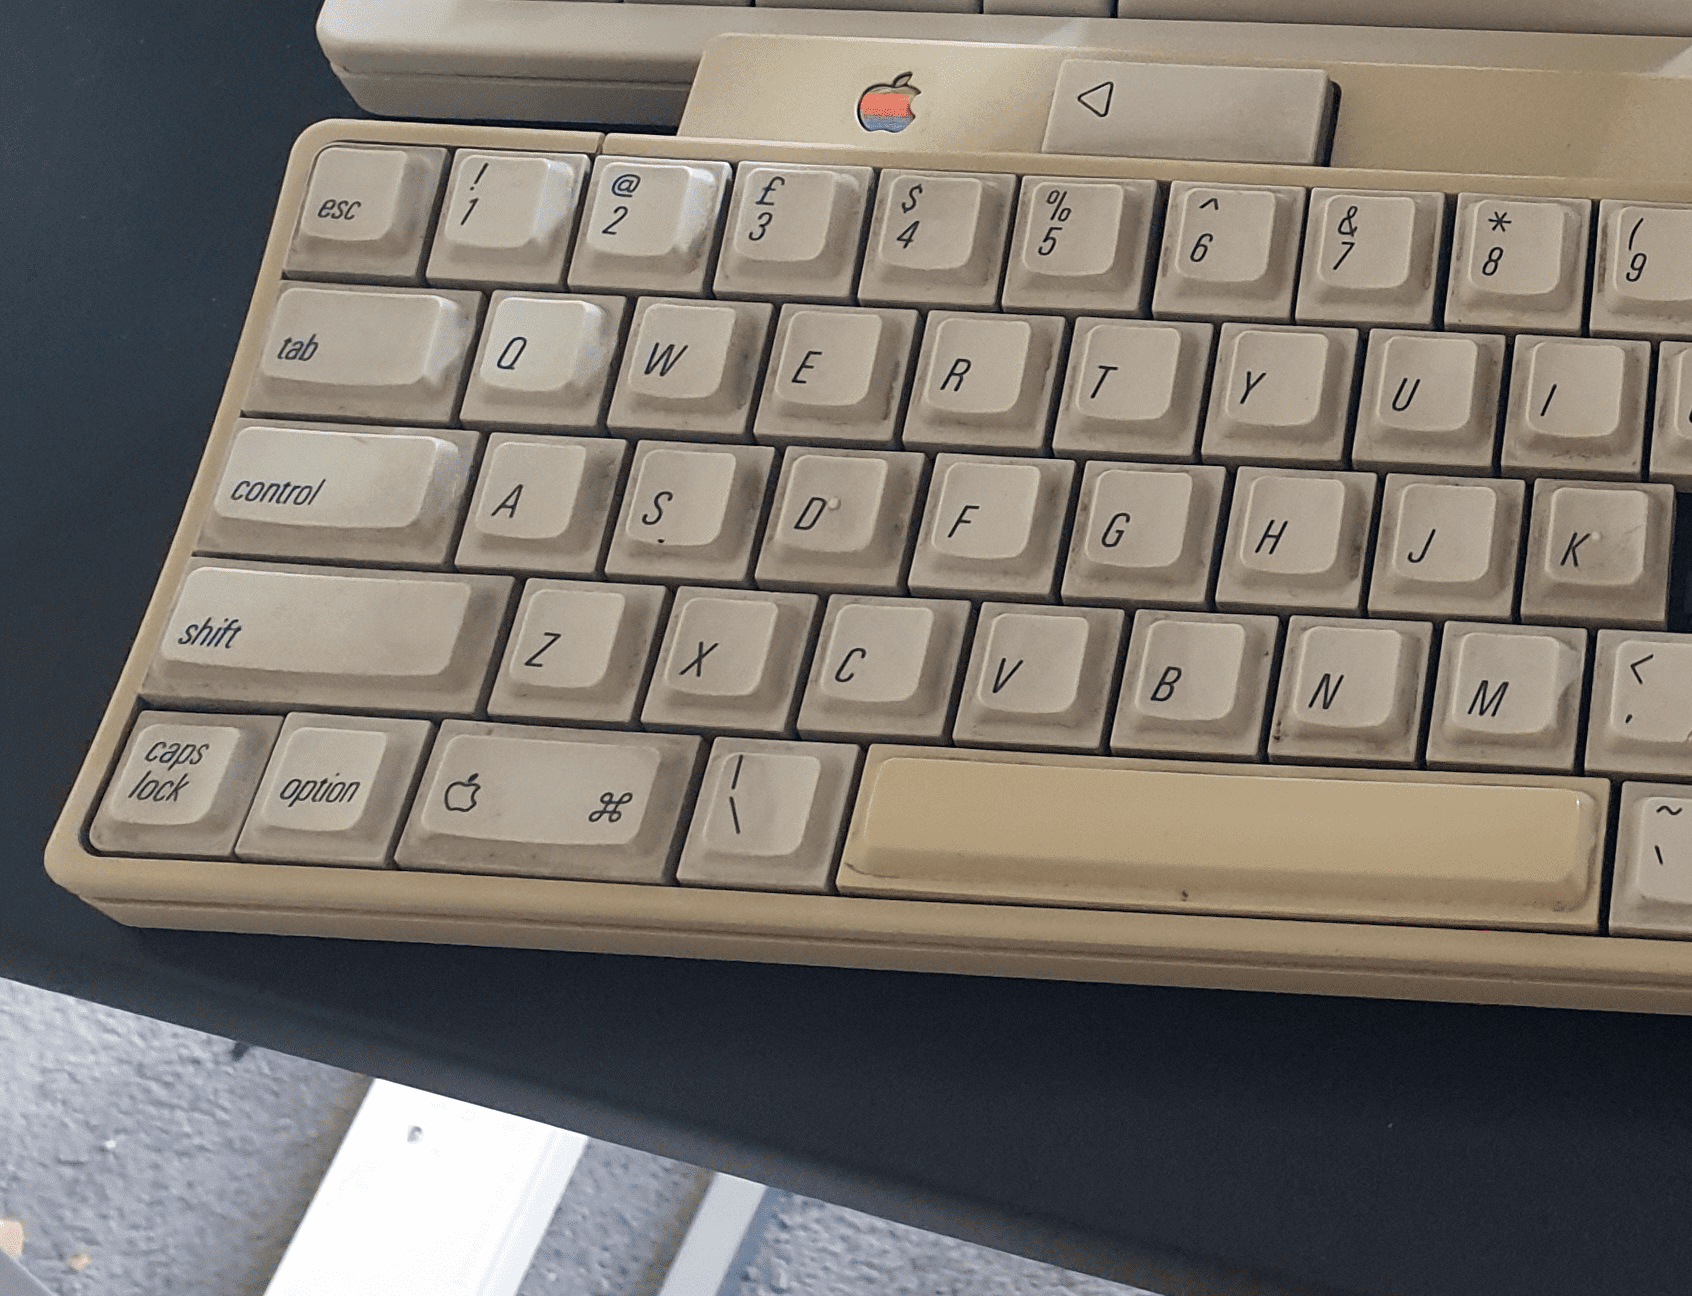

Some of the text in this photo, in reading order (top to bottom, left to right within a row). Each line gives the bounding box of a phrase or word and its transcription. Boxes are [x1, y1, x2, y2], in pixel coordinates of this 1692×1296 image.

[469, 162, 490, 191] !
[611, 173, 642, 198] @
[755, 176, 786, 206] £
[317, 198, 362, 221] esc
[460, 197, 479, 226] 1
[901, 183, 924, 214] $
[1045, 189, 1072, 222] %
[601, 205, 629, 236] 2
[748, 211, 773, 242] 3
[896, 220, 920, 249] 4
[1337, 205, 1359, 238] &
[1628, 217, 1644, 252] (
[1037, 226, 1063, 256] 5
[1189, 232, 1214, 263] 6
[1332, 241, 1356, 271] 7
[1481, 246, 1504, 277] 8
[1625, 252, 1648, 283] 9
[277, 333, 319, 362] tab
[496, 336, 528, 371] Q
[643, 342, 689, 377] W
[791, 350, 823, 384] E
[939, 358, 972, 392] R
[1090, 365, 1119, 399] T
[1239, 370, 1267, 405] Y
[1391, 377, 1421, 412] U
[1539, 383, 1558, 417] I
[230, 478, 327, 506] control
[490, 483, 524, 519] A
[641, 491, 674, 526] S
[793, 496, 828, 531] D
[947, 504, 980, 538] F
[1101, 512, 1131, 548] G
[1254, 519, 1289, 555] H
[1407, 528, 1437, 564] J
[1560, 532, 1592, 568] K
[177, 616, 242, 649] shift
[524, 631, 562, 668] Z
[678, 641, 719, 678] X
[834, 647, 867, 683] C
[992, 657, 1024, 694] V
[1630, 653, 1654, 685] <
[1149, 665, 1182, 702] B
[1307, 673, 1345, 710] N
[1467, 679, 1510, 718] M
[144, 741, 210, 768] caps
[127, 769, 190, 802] lock
[279, 773, 361, 808] option
[728, 796, 741, 835] \
